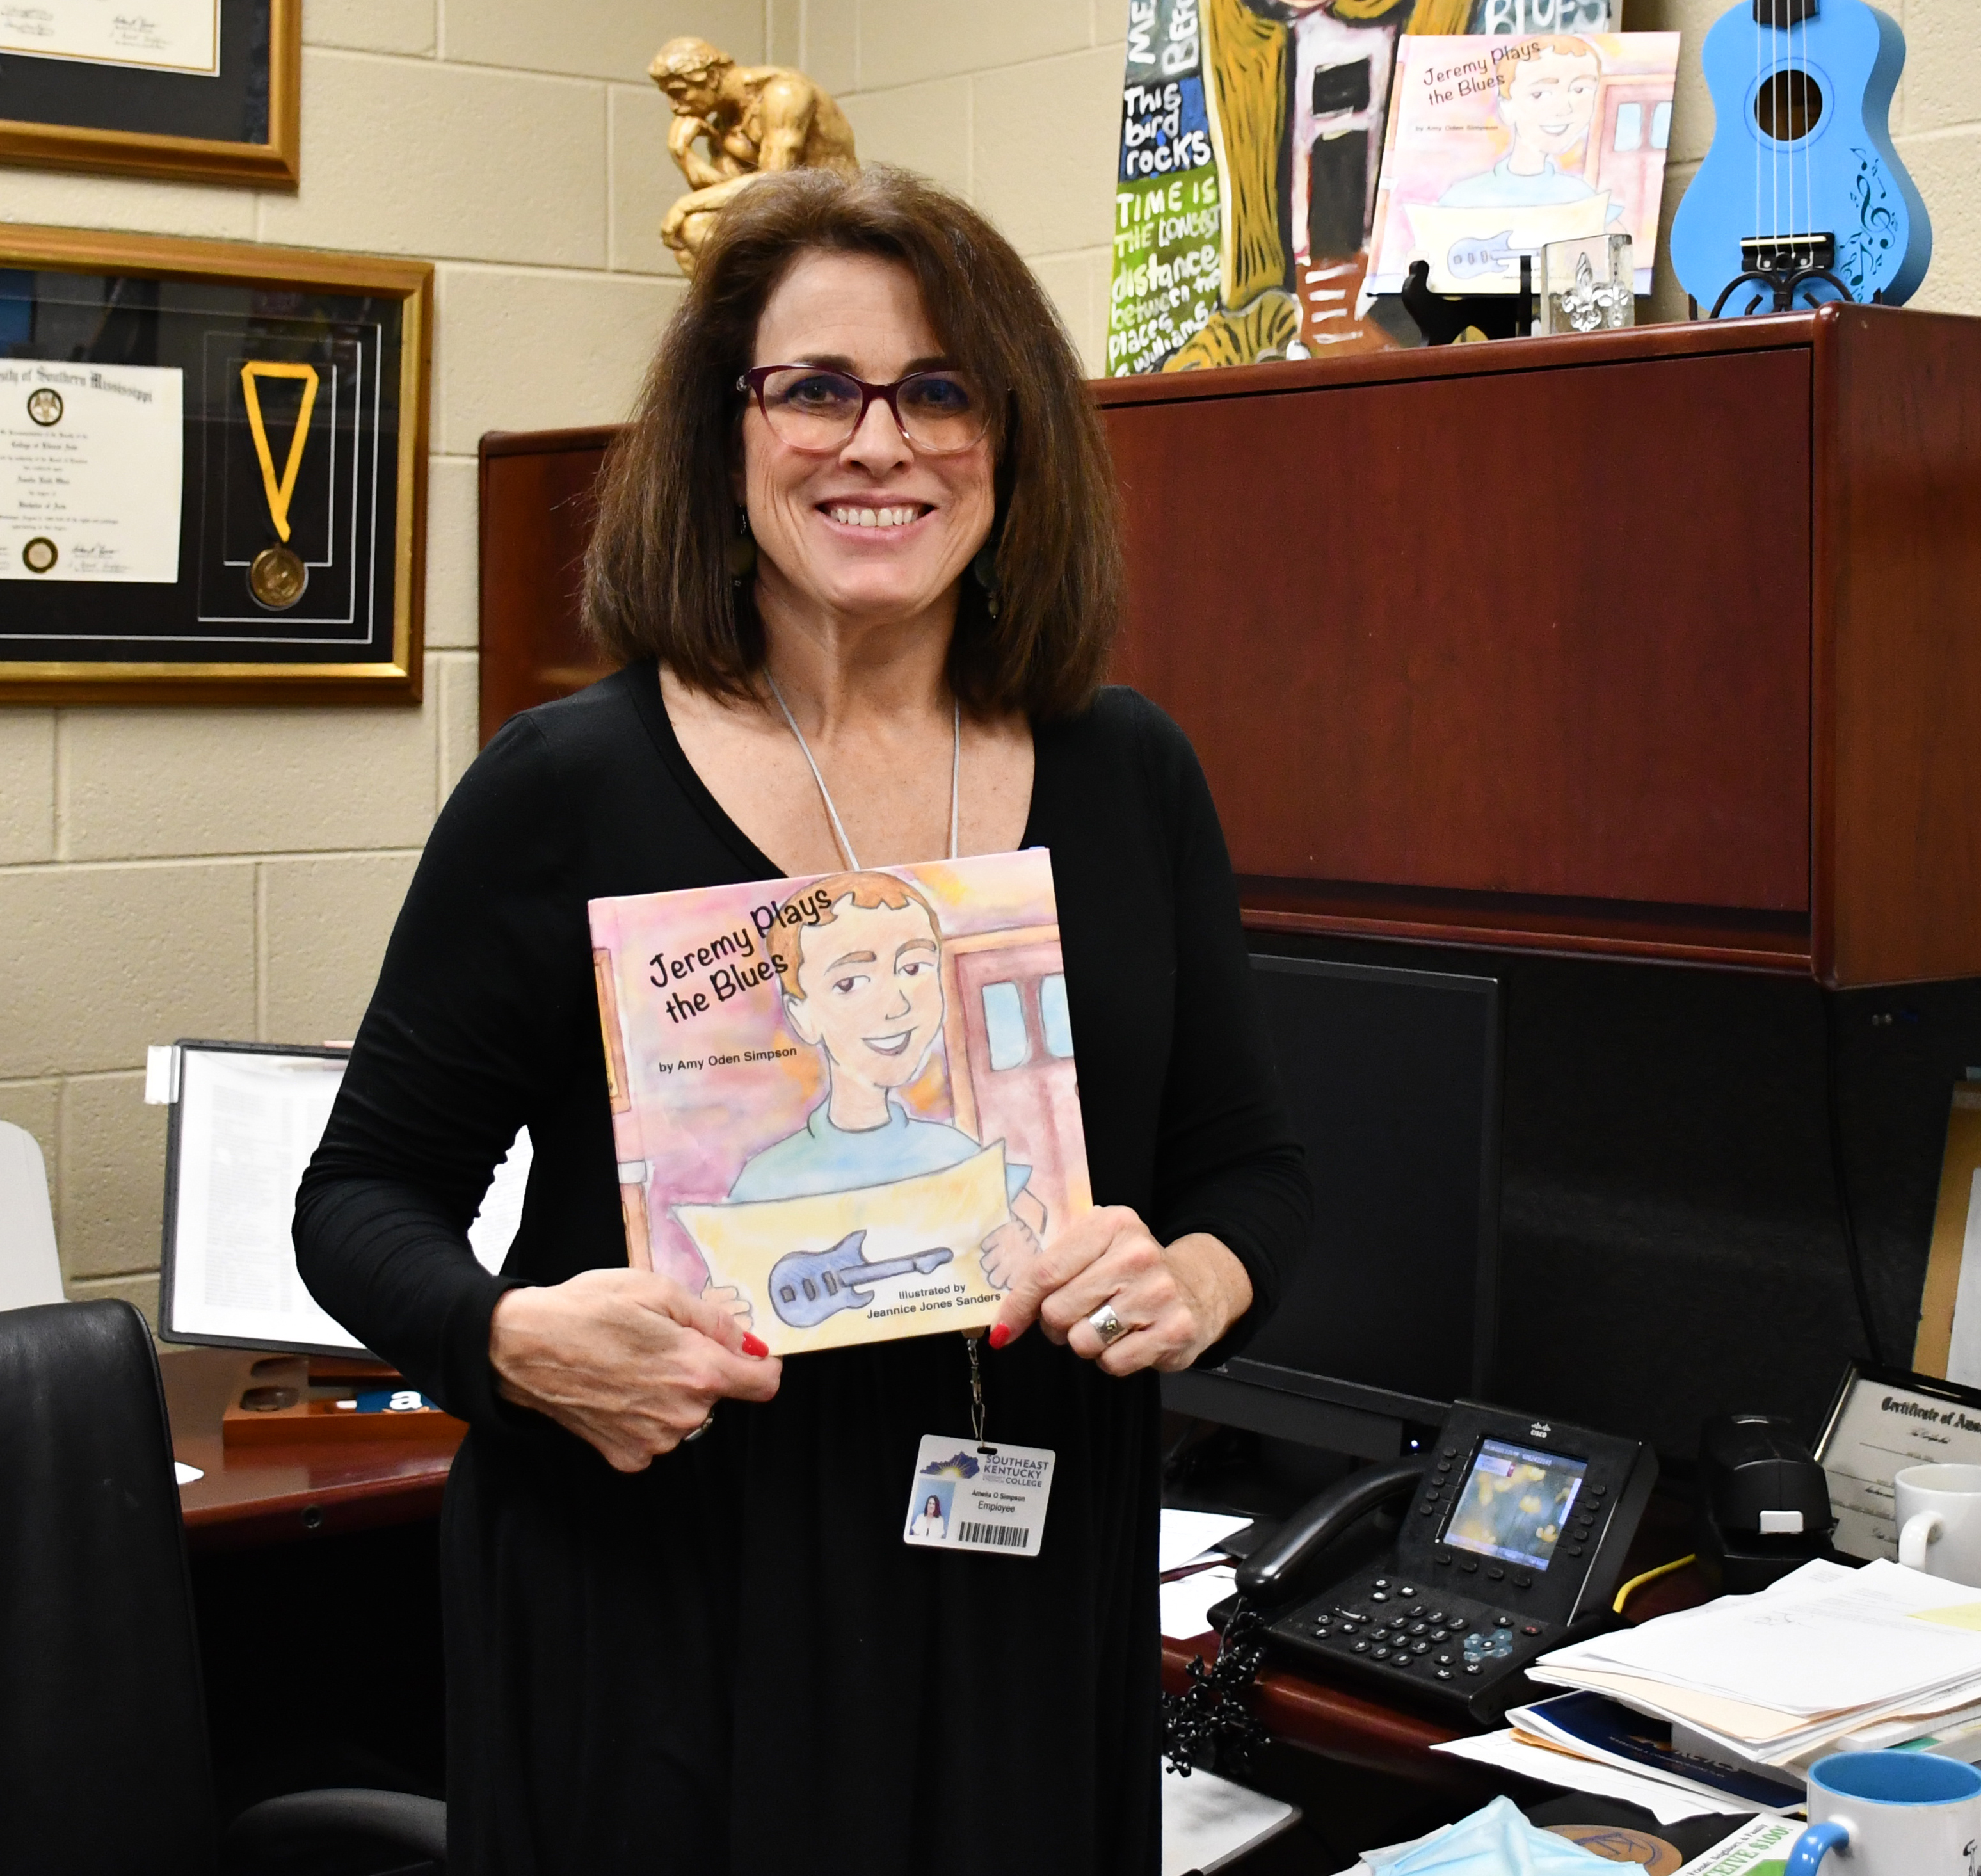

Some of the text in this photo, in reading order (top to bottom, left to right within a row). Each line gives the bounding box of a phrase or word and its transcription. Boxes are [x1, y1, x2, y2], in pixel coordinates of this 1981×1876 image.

[1423, 42, 1541, 86] Jeremy Plays
[1429, 74, 1505, 106] the Blues
[1125, 108, 1180, 147] bird
[1116, 180, 1183, 228] TIME
[1114, 221, 1155, 259] THE
[1111, 245, 1220, 304] distance
[649, 889, 832, 988] Jeremy Plays
[666, 954, 788, 1023] the Blues
[659, 1047, 798, 1074] by Amy Oden Simpson
[867, 1292, 1002, 1319] Jeannice Jones Sanders
[899, 1284, 966, 1300] Illustrated by
[1881, 1396, 1940, 1422] Certificate
[1940, 1411, 1955, 1425] of
[984, 1465, 1042, 1479] KENTUCKY
[986, 1455, 1049, 1471] SOUTHEAST
[1006, 1477, 1042, 1488] COLLEGE
[978, 1500, 1015, 1513] Employee
[1000, 1493, 1025, 1502] Simpson
